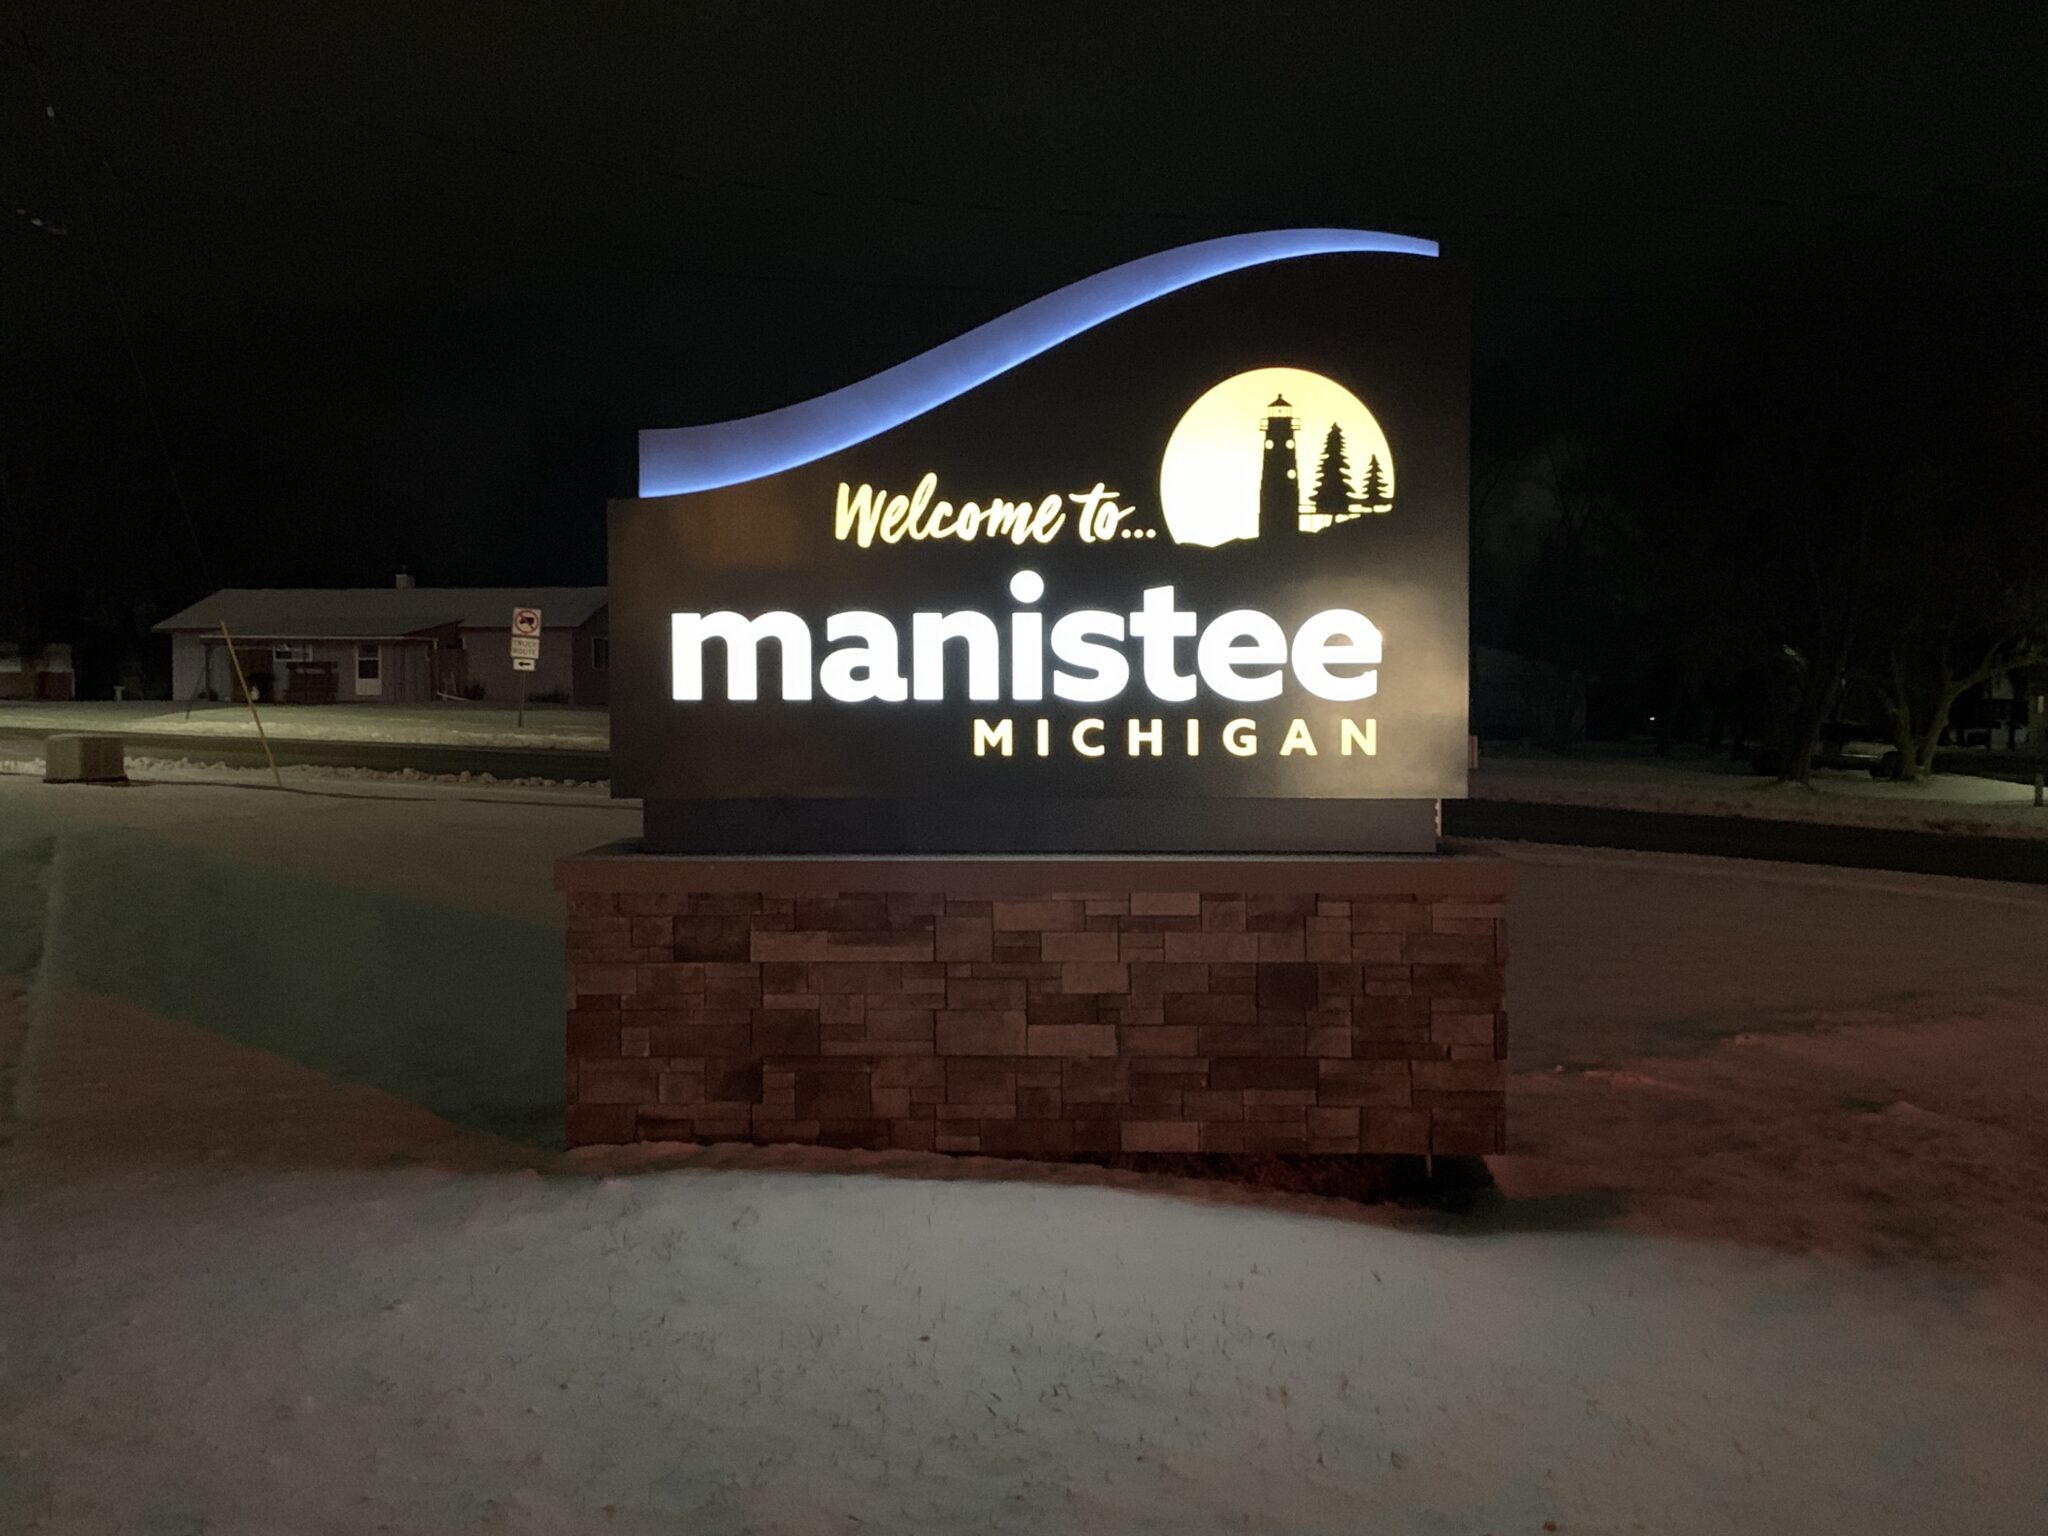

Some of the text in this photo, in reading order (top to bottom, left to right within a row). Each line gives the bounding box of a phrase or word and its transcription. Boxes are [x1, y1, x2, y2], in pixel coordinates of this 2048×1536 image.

[835, 472, 1156, 548] Welcome to...
[512, 647, 537, 656] ROUTE
[513, 639, 537, 648] TRUCK
[671, 570, 1382, 702] manistee
[974, 718, 1378, 757] MICHIGAN
